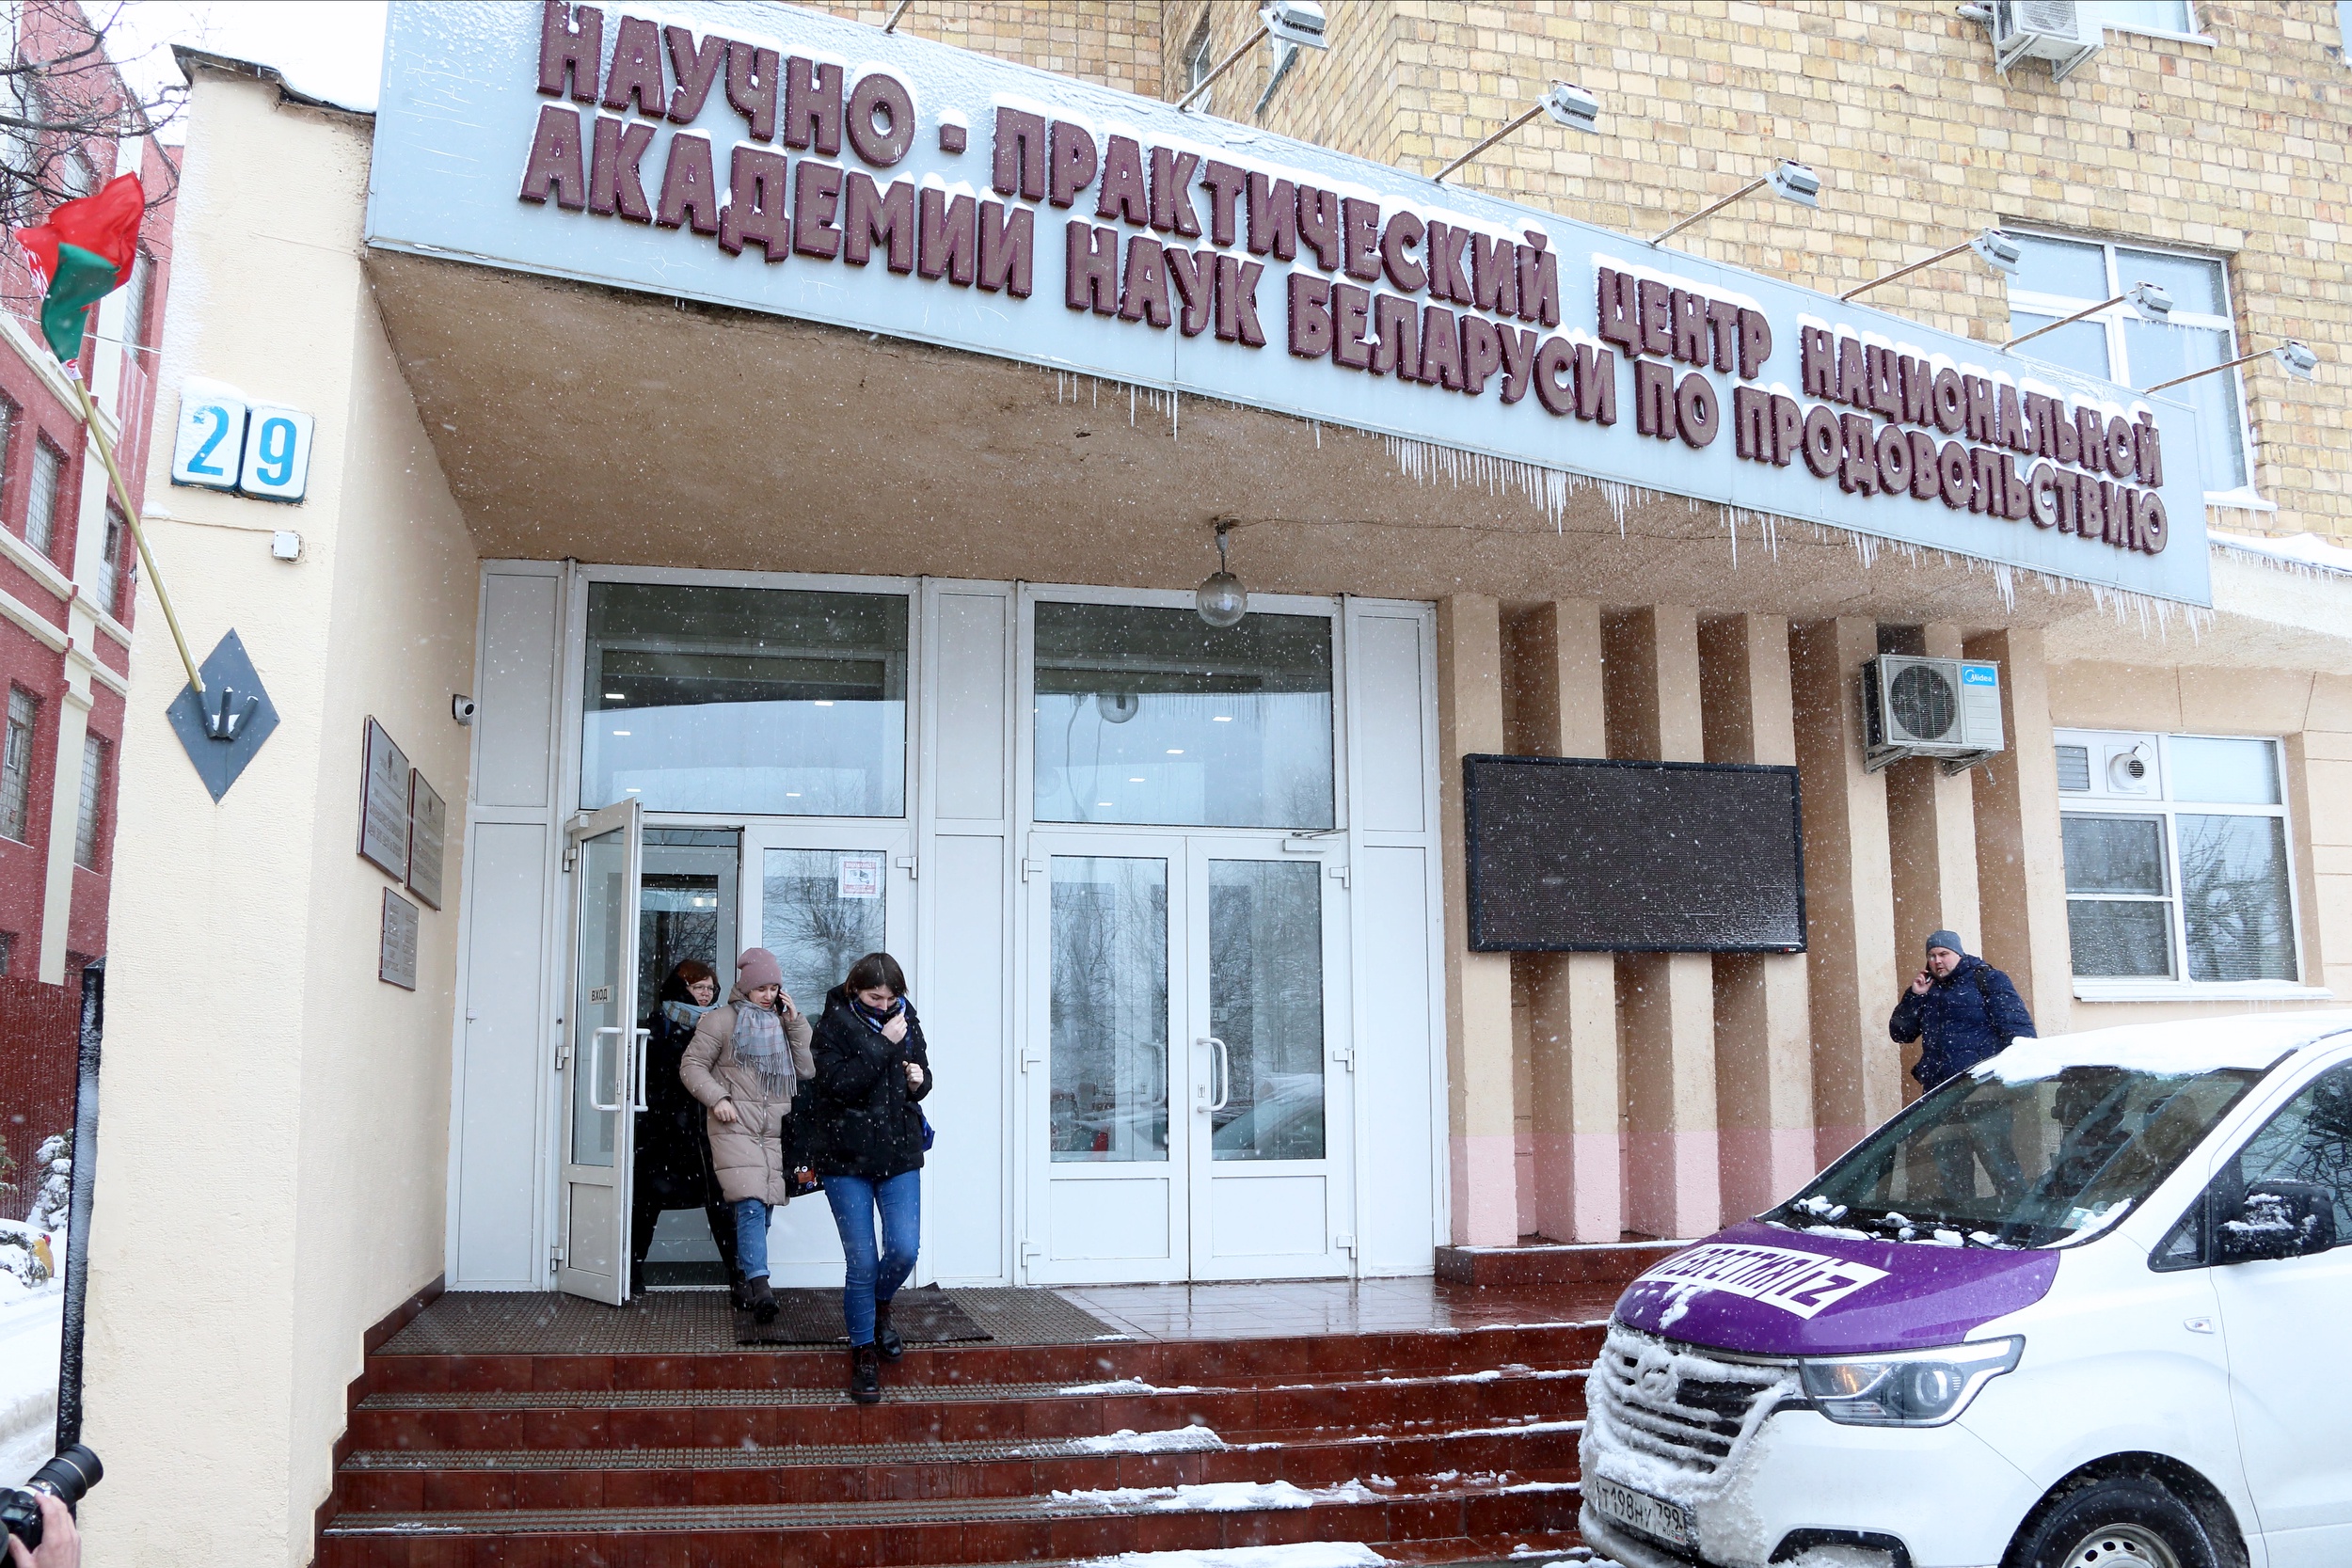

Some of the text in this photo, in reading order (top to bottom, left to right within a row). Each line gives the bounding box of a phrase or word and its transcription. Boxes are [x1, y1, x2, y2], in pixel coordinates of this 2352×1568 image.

[535, 1, 915, 167] НАУЧНО
[993, 107, 1560, 328] ПРАКТИЧЕСКИЙ
[1597, 267, 1772, 380] ЦЕНТР
[1801, 325, 2164, 488] НАЦИОНАЛЬНОЙ
[518, 103, 2168, 555] АКАДЕМИИ НАУК БЕЛАРУСИ ПО ПРОДОВОЛЬСТВИЮ
[187, 405, 297, 487] 29
[1964, 669, 1993, 683] Midea
[591, 988, 608, 1002] ВХОД
[1649, 1248, 1813, 1290] ИЗВЕСТИЯ
[1662, 1526, 1675, 1538] RUS
